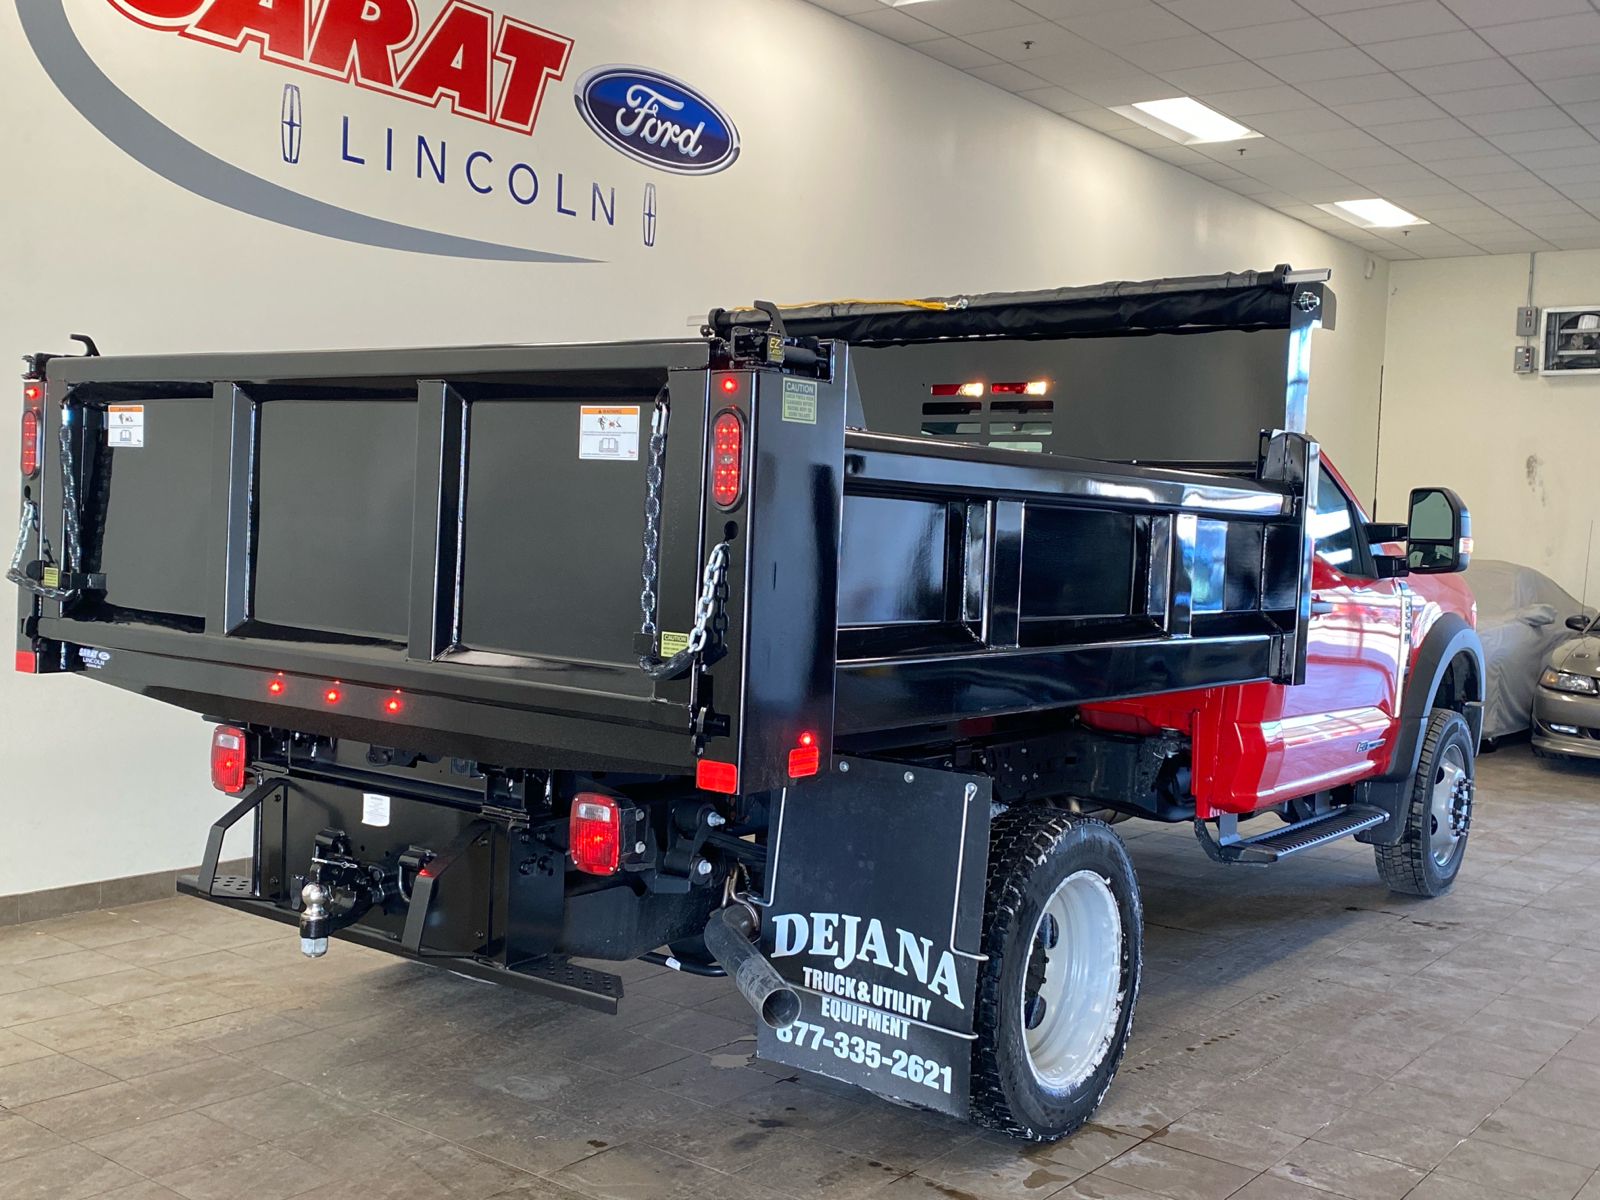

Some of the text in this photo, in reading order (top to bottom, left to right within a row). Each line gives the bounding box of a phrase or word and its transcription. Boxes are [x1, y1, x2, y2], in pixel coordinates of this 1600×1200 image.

[107, 0, 575, 136] ARAT
[615, 84, 706, 158] Ford
[341, 116, 616, 226] LINCOLN
[786, 382, 814, 394] CAUTION
[82, 657, 105, 666] LINCOLN
[664, 634, 687, 642] CAUTION
[770, 912, 965, 1010] DEJANA
[802, 966, 857, 999] TRUCK
[872, 984, 932, 1021] UTILITY
[821, 996, 911, 1041] EQUIPMENT
[776, 1020, 952, 1094] 877-335-2621
